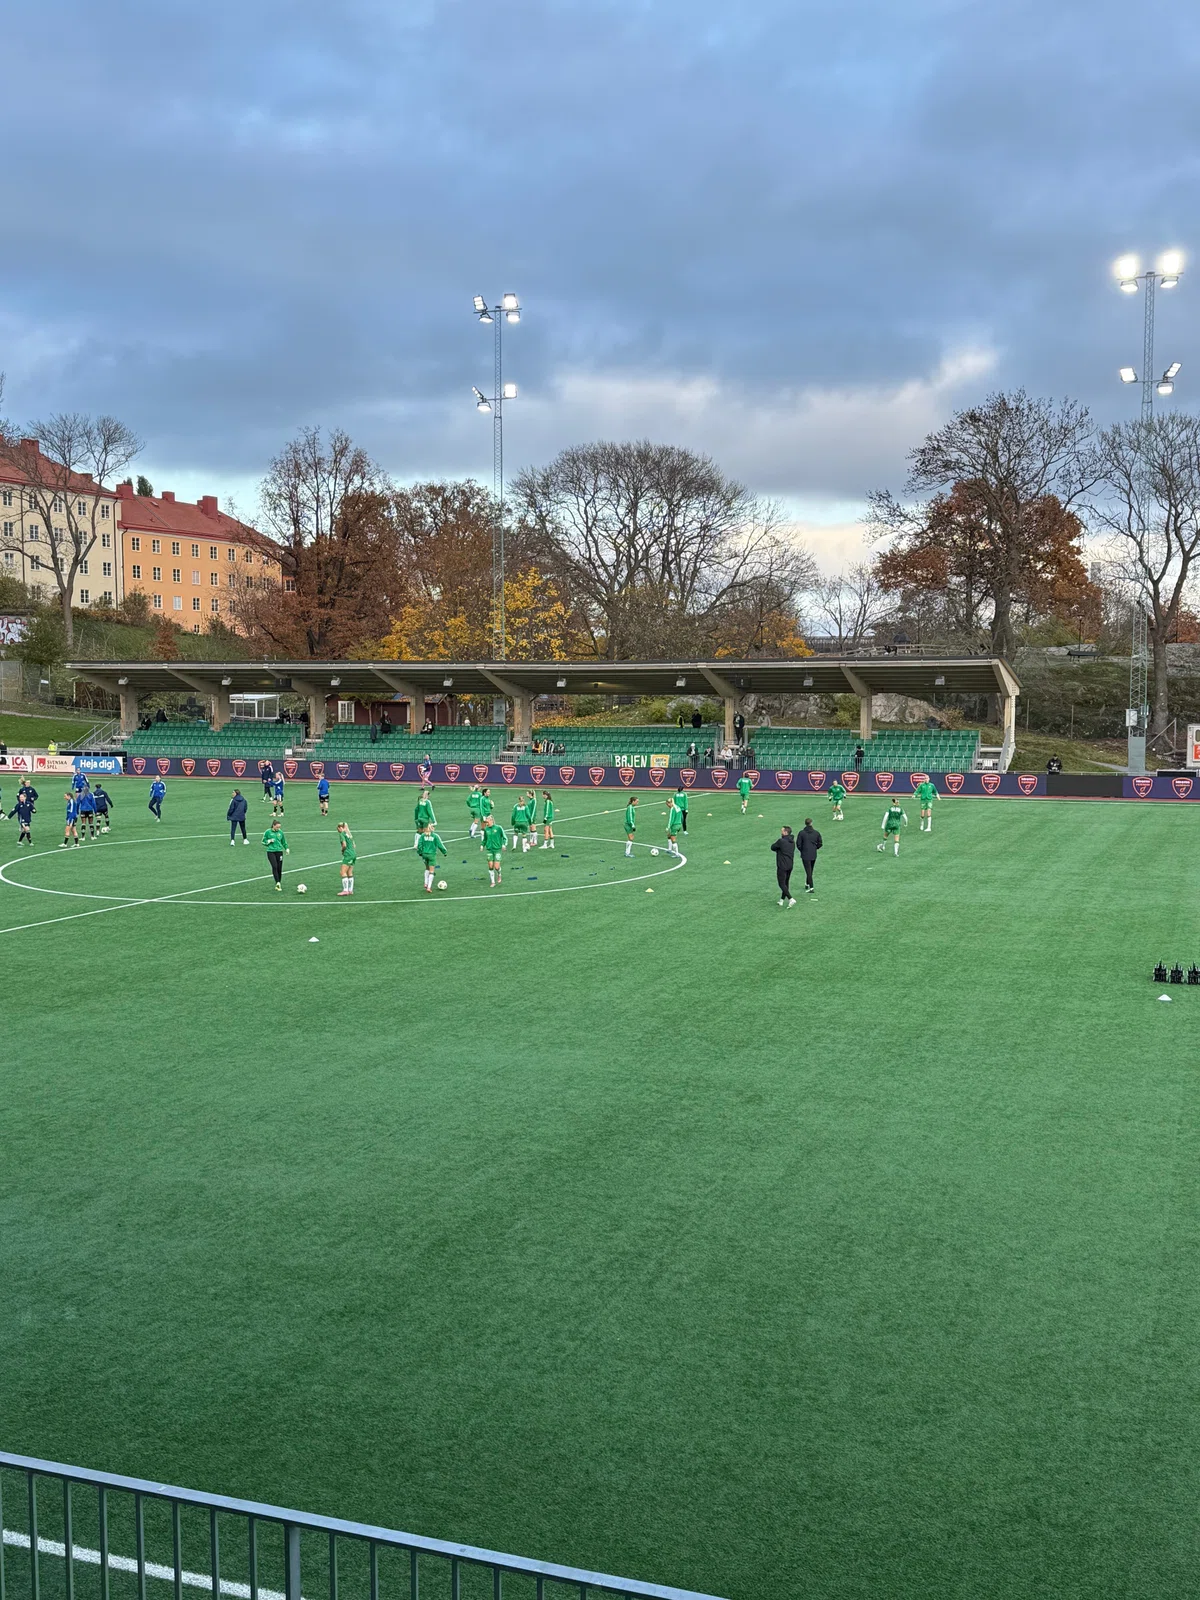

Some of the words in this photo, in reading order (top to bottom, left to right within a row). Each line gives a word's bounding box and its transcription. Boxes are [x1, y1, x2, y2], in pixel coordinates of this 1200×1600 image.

[12, 756, 27, 766] ICA
[80, 759, 98, 769] Heja
[98, 759, 115, 770] dig!
[614, 755, 647, 768] BAJEN
